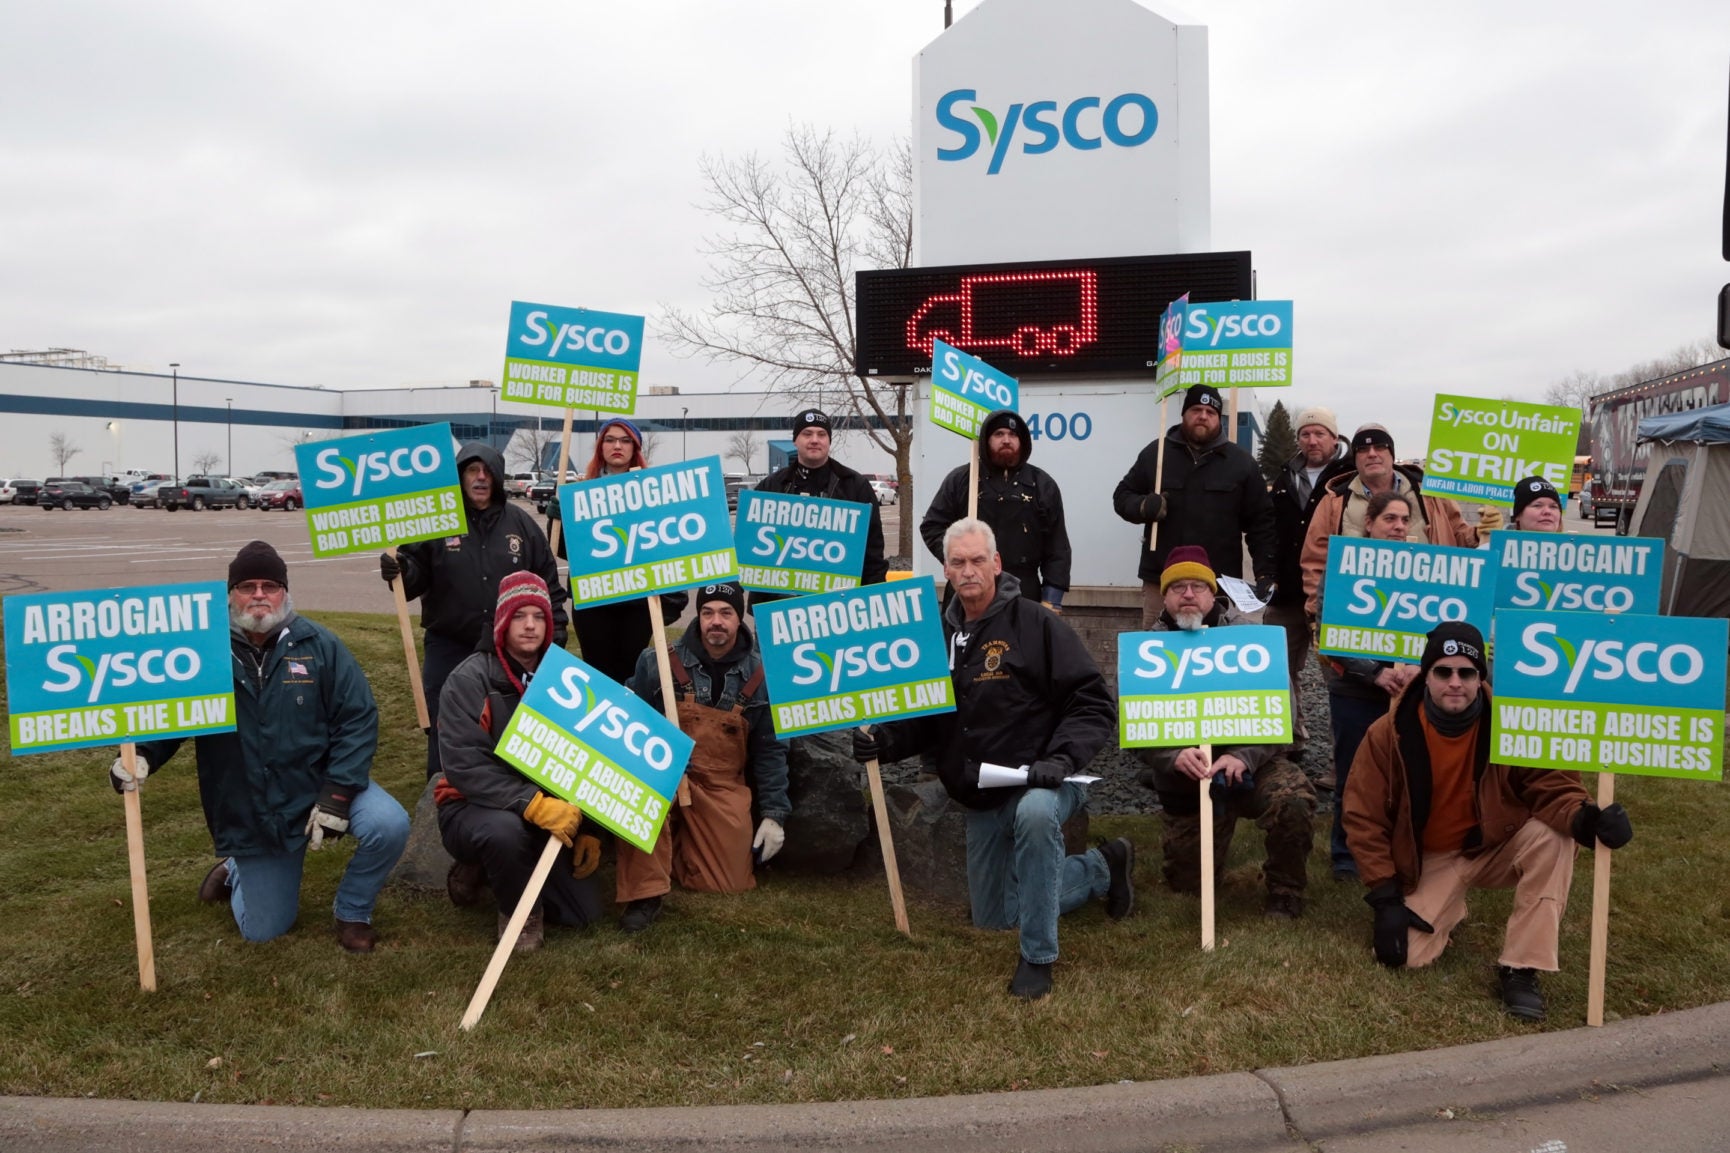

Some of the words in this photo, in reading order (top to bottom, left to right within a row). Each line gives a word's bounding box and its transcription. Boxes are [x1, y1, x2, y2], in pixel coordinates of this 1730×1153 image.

[936, 89, 1158, 175] Sysco
[520, 311, 630, 357] Sysco
[1185, 309, 1281, 346] Sysco
[508, 362, 566, 384] WORKER
[570, 370, 615, 389] ABUSE
[618, 375, 633, 391] IS
[941, 351, 1012, 407] Sysco
[1180, 370, 1200, 383] BAD
[1204, 369, 1225, 383] FOR
[1229, 368, 1286, 382] BUSINESS
[1181, 354, 1228, 369] WORKER
[1232, 353, 1271, 367] ABUSE
[1274, 352, 1287, 366] IS
[507, 381, 533, 398] BAD
[537, 384, 563, 401] FOR
[566, 388, 630, 409] BUSINESS
[934, 388, 974, 420] WORKER
[934, 406, 953, 424] BAD
[955, 416, 972, 433] FOR
[1026, 412, 1092, 441] 400
[1438, 402, 1498, 427] Sysco
[1501, 409, 1573, 435] Unfair:
[1482, 431, 1519, 452] ON
[315, 444, 440, 496] Sysco
[1426, 478, 1454, 490] UNFAIR
[1456, 481, 1483, 494] LABOR
[1486, 486, 1514, 499] PRACT
[1429, 448, 1567, 489] STRIKE
[312, 504, 380, 531] WORKER
[385, 496, 436, 520] ABUSE
[439, 492, 457, 510] IS
[573, 466, 710, 522] ARROGANT
[317, 532, 348, 551] BAD
[352, 526, 382, 546] FOR
[385, 513, 459, 541] BUSINESS
[746, 498, 861, 534] ARROGANT
[590, 513, 706, 564] Sysco
[752, 526, 846, 566] Sysco
[1502, 539, 1650, 575] ARROGANT
[577, 568, 648, 600] BREAKS
[651, 560, 687, 586] THE
[690, 552, 731, 580] LAW
[738, 566, 790, 587] BREAKS
[794, 571, 820, 590] THE
[1339, 545, 1485, 588] ARROGANT
[23, 593, 212, 644] ARROGANT
[771, 587, 923, 645] ARROGANT
[1346, 578, 1468, 627] Sysco
[1325, 628, 1397, 653] BREAKS
[1402, 635, 1426, 657] TH
[1513, 622, 1704, 694] Sysco
[42, 645, 200, 703] Sysco
[792, 638, 920, 692] Sysco
[1134, 640, 1270, 689] Sysco
[19, 708, 117, 744] BREAKS
[124, 704, 169, 732] THE
[177, 697, 227, 727] LAW
[546, 666, 673, 771] Sysco
[778, 696, 856, 730] BREAKS
[860, 690, 899, 716] THE
[903, 681, 946, 709] LAW
[1125, 699, 1197, 720] WORKER
[1203, 697, 1260, 716] ABUSE
[1265, 696, 1283, 714] IS
[1499, 705, 1597, 735] WORKER
[1603, 711, 1681, 740] ABUSE
[1689, 717, 1714, 743] IS
[1126, 722, 1159, 741] BAD
[1164, 721, 1196, 740] FOR
[1200, 718, 1284, 738] BUSINESS
[516, 711, 590, 772] WORKER
[588, 760, 644, 808] ABUSE
[642, 795, 662, 821] IS
[1499, 733, 1543, 759] BAD
[1550, 737, 1592, 762] FOR
[1600, 740, 1712, 772] BUSINESS
[504, 733, 543, 769] BAD
[541, 757, 577, 791] FOR
[575, 779, 653, 841] BUSINESS
